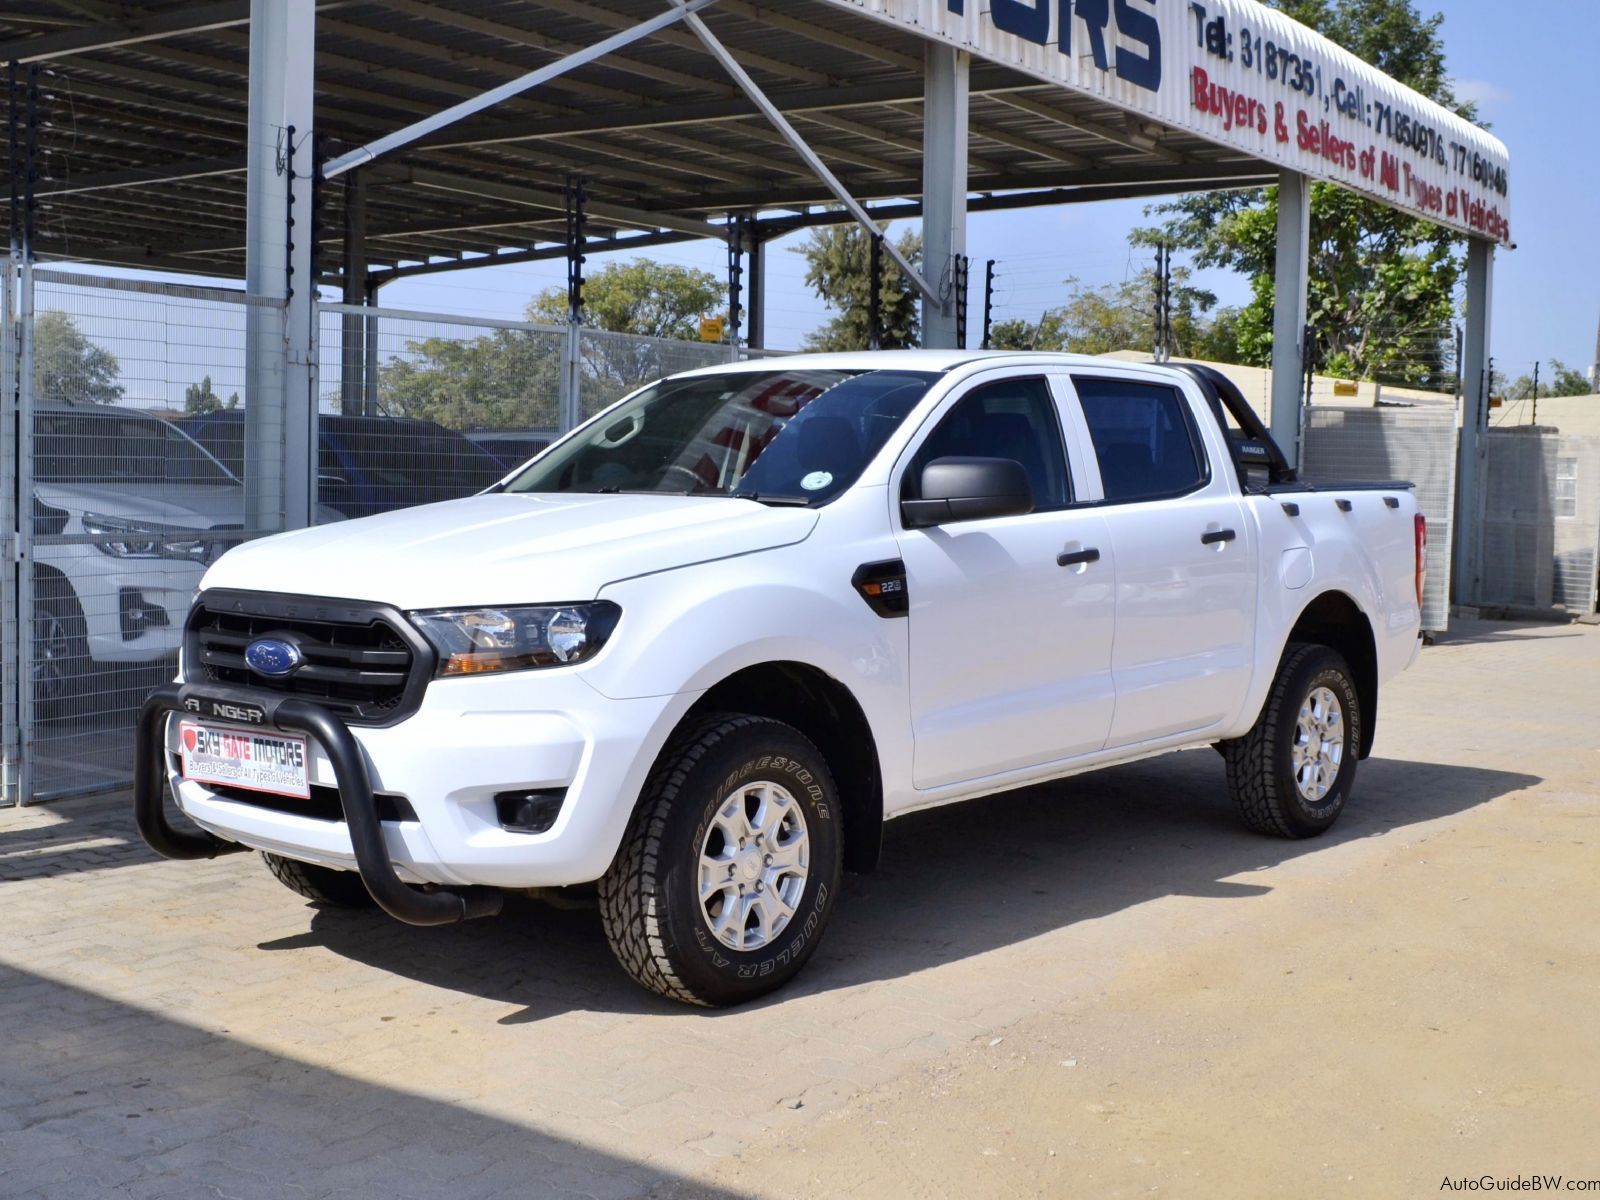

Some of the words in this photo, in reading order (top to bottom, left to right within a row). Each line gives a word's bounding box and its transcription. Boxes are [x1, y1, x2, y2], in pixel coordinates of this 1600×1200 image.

[1191, 1, 1233, 63] Tel:
[1193, 65, 1267, 134] Buyers
[1274, 101, 1289, 143] &
[1297, 109, 1356, 171] Sellers
[1360, 145, 1376, 181] of
[1380, 150, 1399, 193] All
[1402, 160, 1443, 212] Types
[1460, 189, 1510, 242] Vehicles
[1241, 445, 1265, 455] RANGER
[186, 698, 262, 723] RNGER
[197, 730, 220, 757] SKY
[223, 734, 251, 761] GATE
[253, 737, 304, 767] MOTORS
[694, 926, 730, 968] A/T
[737, 882, 828, 978] DUELER
